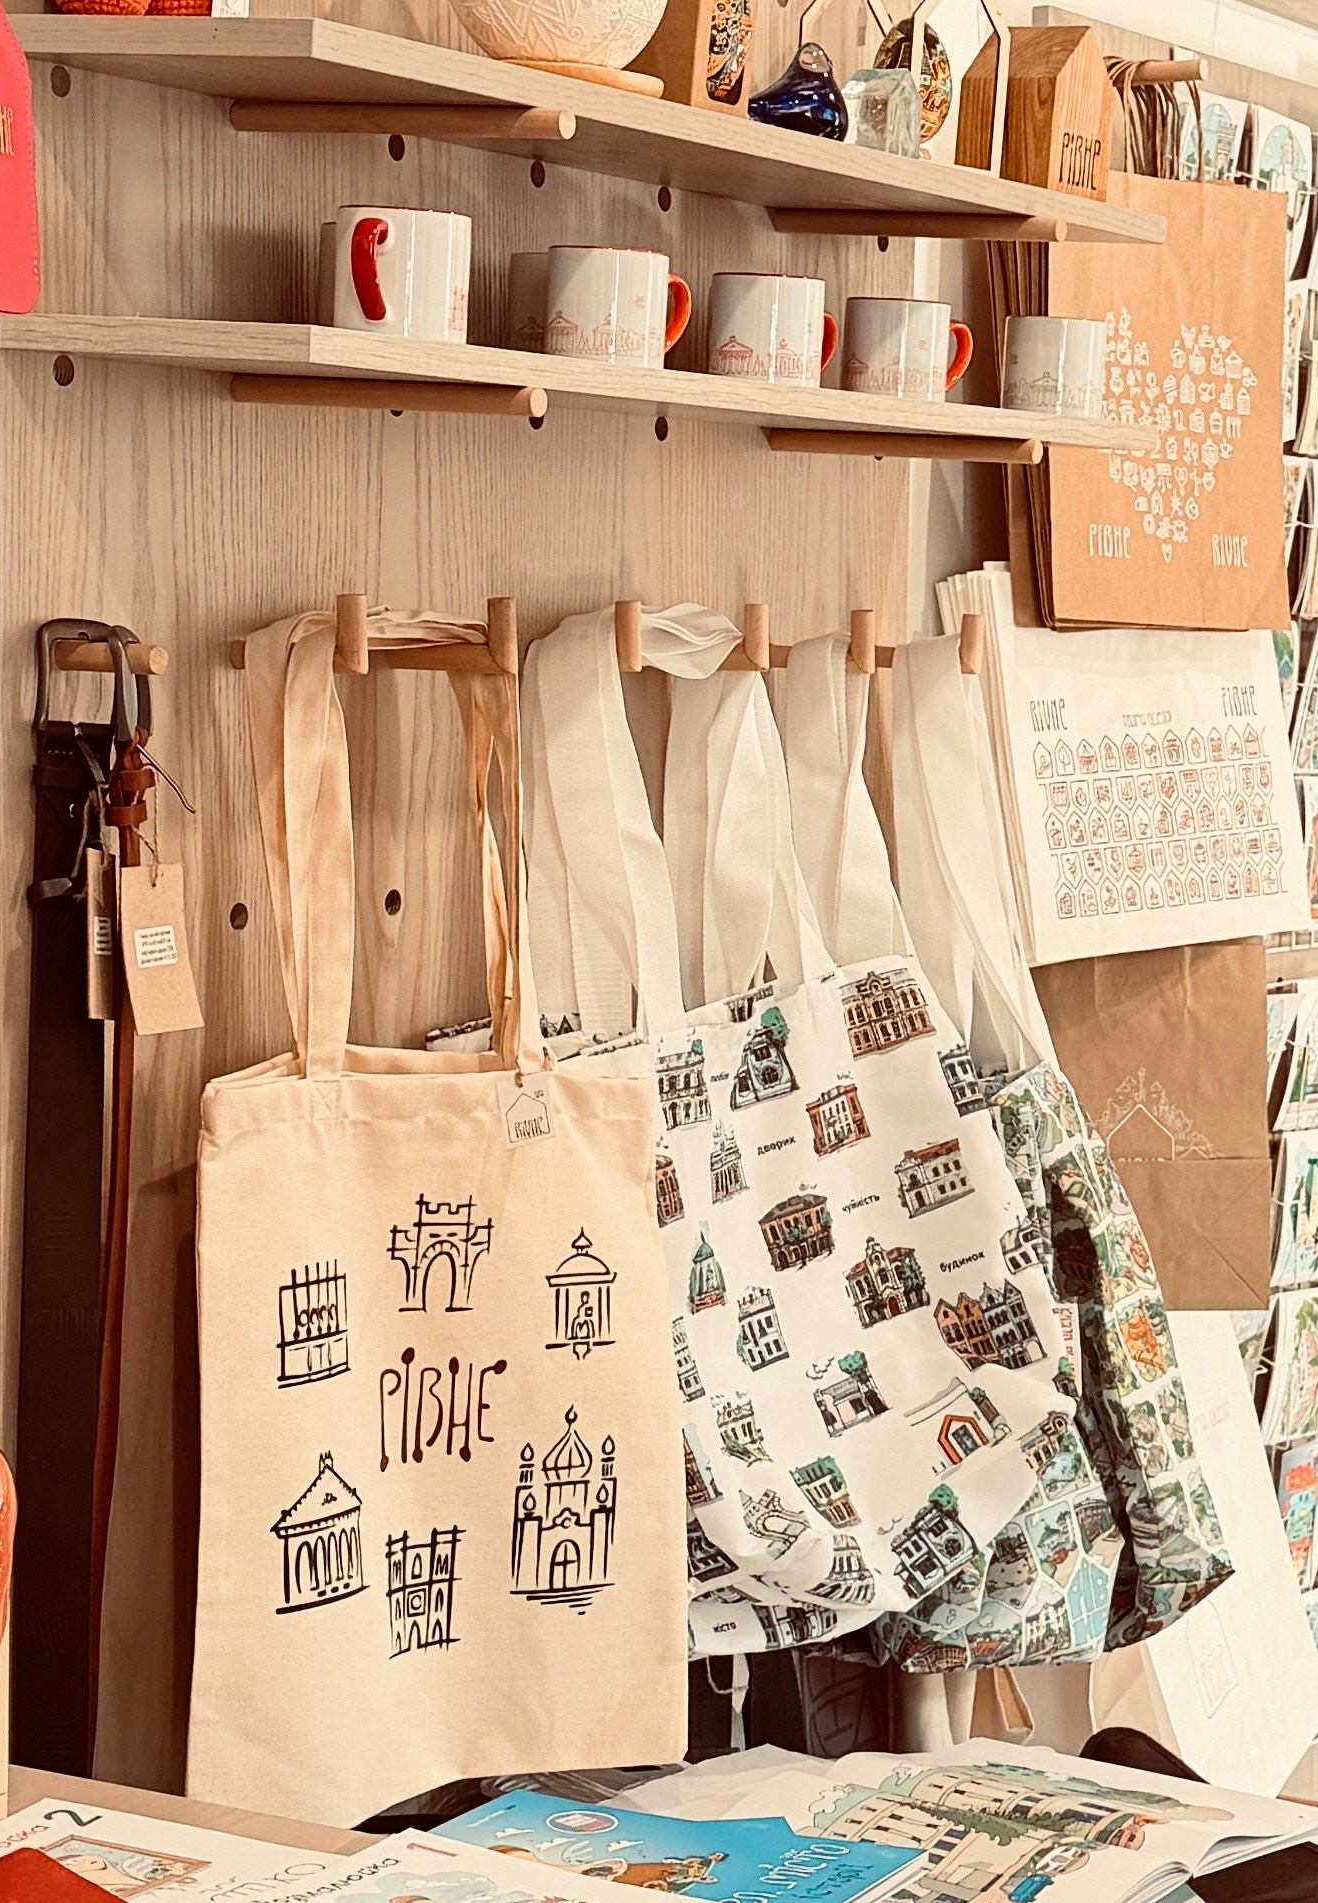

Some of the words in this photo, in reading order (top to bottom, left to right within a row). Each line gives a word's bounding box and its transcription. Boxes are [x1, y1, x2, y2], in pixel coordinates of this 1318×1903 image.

[1061, 131, 1103, 192] РІВНЕ
[1088, 522, 1132, 560] РІВНЕ
[1210, 535, 1250, 568] RIVNE
[1029, 698, 1069, 733] RIVNE
[757, 1134, 798, 1157] дворик
[939, 1251, 985, 1273] будинок
[379, 1346, 508, 1473] РІВНЕ
[42, 1808, 103, 1829] 2
[406, 1842, 458, 1858] 1
